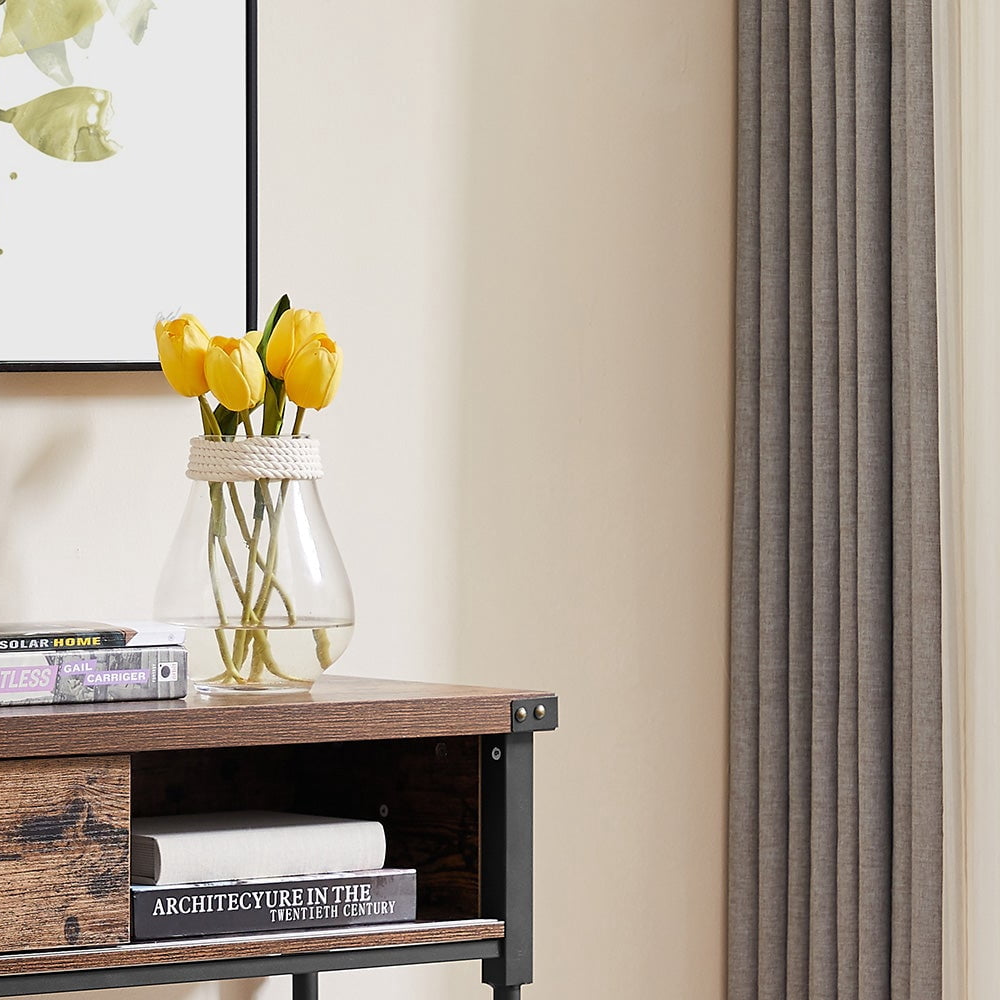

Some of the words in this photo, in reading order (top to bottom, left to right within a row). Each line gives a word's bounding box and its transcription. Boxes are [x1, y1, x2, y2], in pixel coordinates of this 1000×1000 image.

[53, 636, 101, 647] HOME
[63, 662, 93, 673] GAIL
[86, 671, 146, 683] CARRIGER
[152, 888, 303, 916] ARCHITECYURE
[306, 886, 328, 906] IN
[331, 883, 371, 903] THE
[269, 904, 338, 922] TWENTIETH
[343, 900, 396, 917] CENTURY
